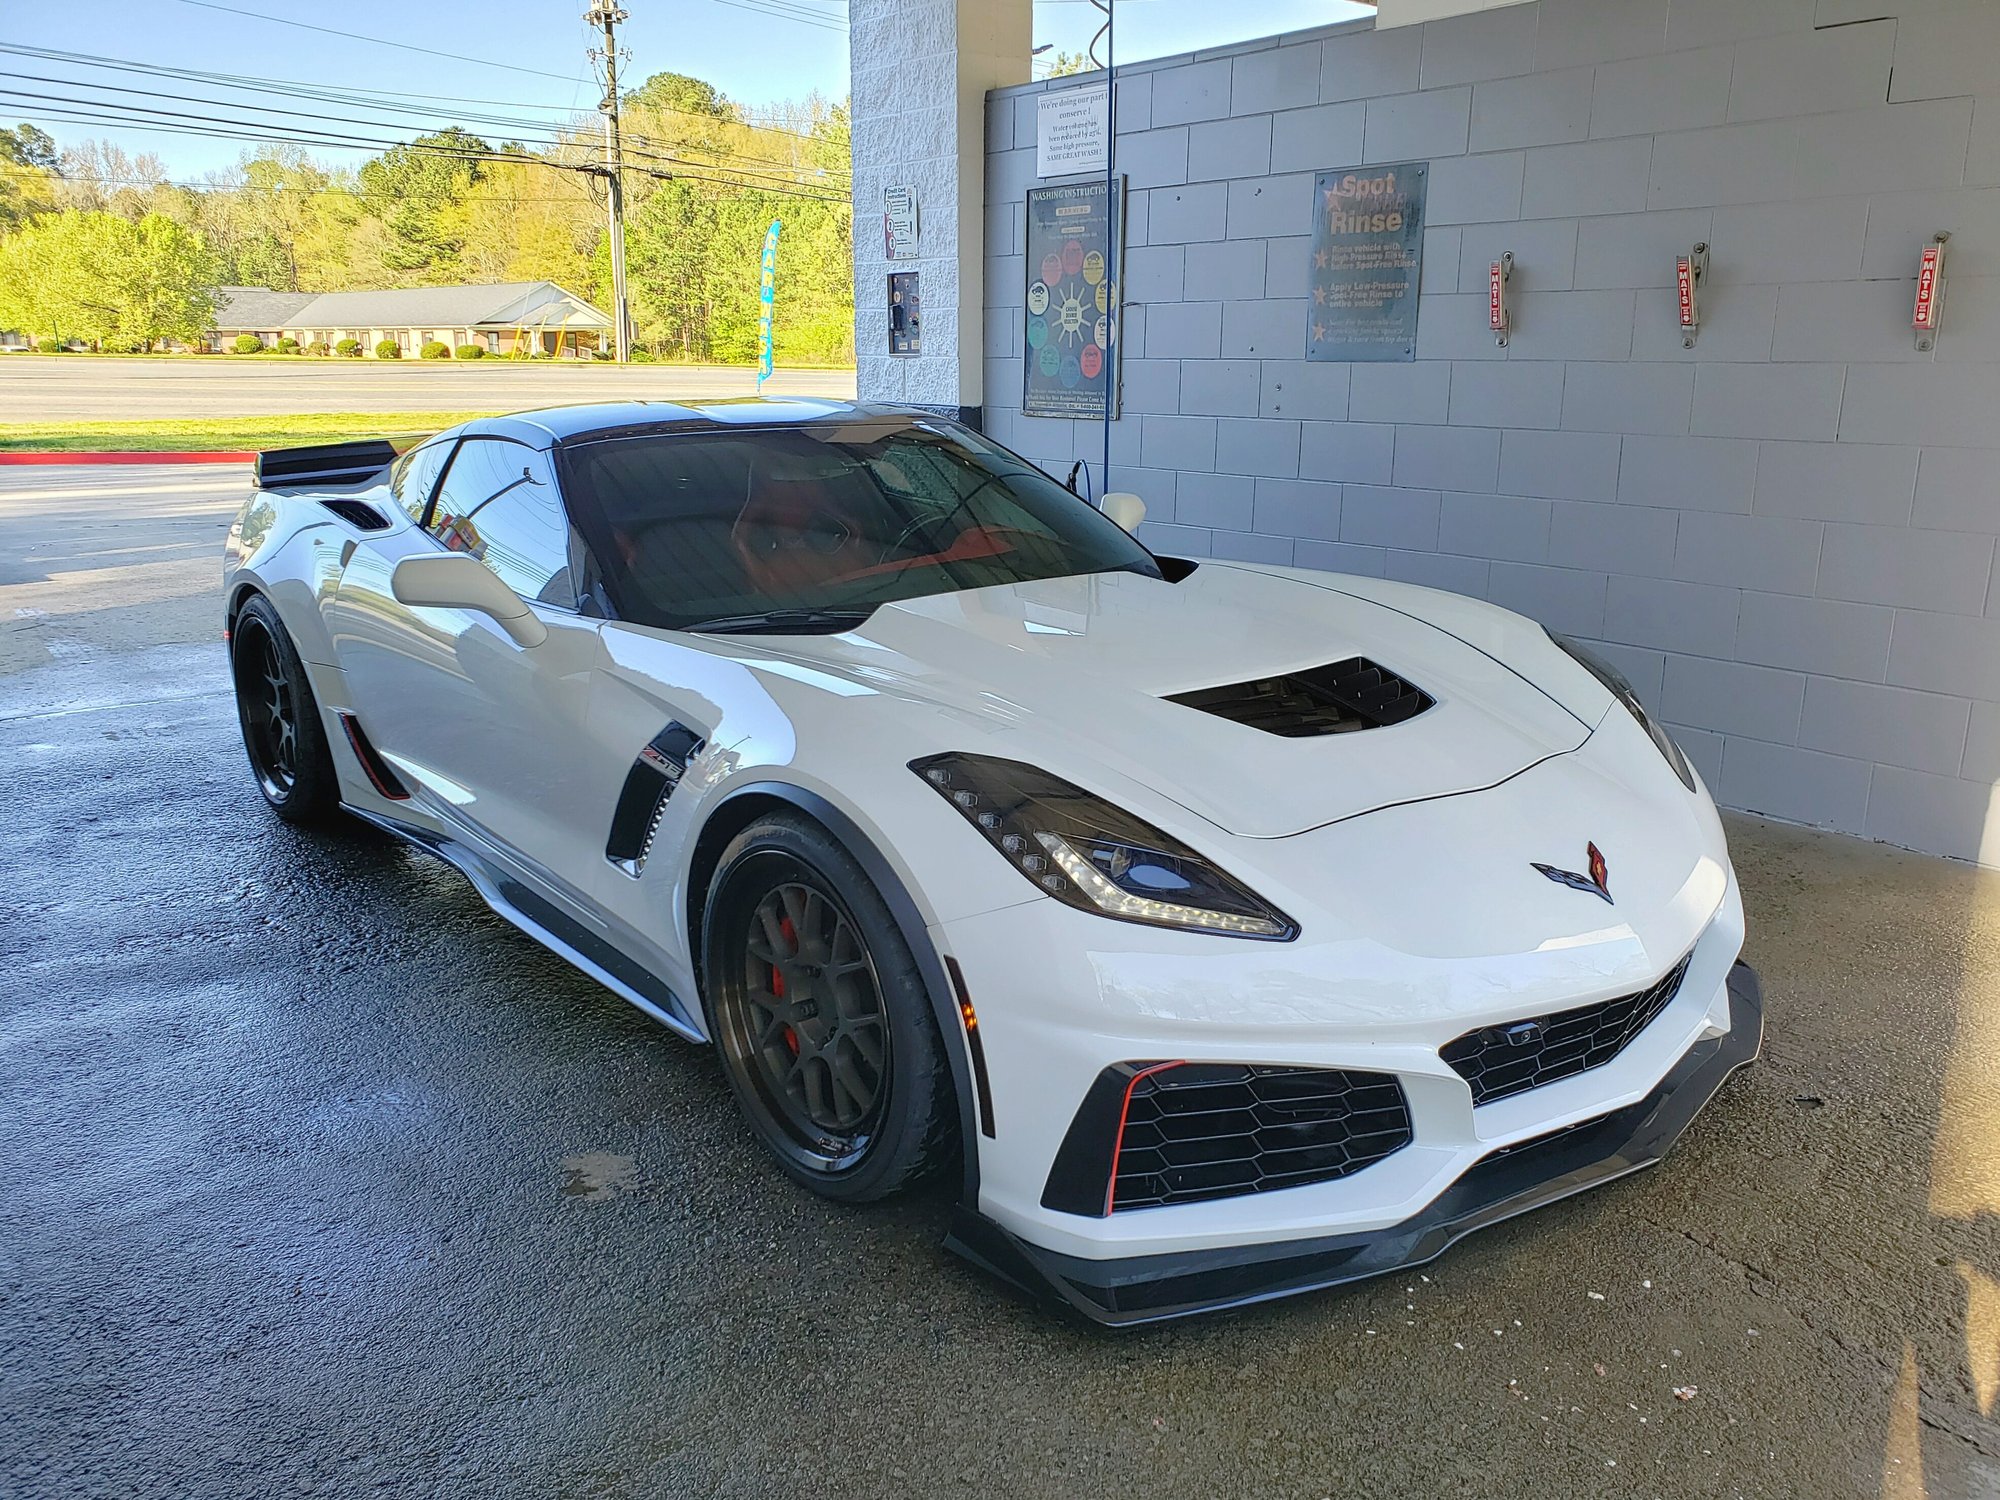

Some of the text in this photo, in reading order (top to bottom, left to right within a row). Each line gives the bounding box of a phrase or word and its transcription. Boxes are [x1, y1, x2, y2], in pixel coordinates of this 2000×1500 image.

[1059, 99, 1077, 107] doing
[1090, 93, 1104, 104] part
[1059, 108, 1087, 119] conserve
[1062, 150, 1081, 159] GREAT
[1081, 149, 1099, 157] WASH
[1031, 184, 1117, 201] WASHING INSTRUCTIOS
[1342, 172, 1396, 201] Spot
[1331, 210, 1403, 235] Rinse
[1329, 282, 1352, 293] Apply
[1679, 271, 1689, 304] MATS
[1920, 260, 1933, 300] MATS
[1369, 289, 1393, 299] Rinse
[1394, 289, 1404, 298] to
[1491, 274, 1499, 306] MATS
